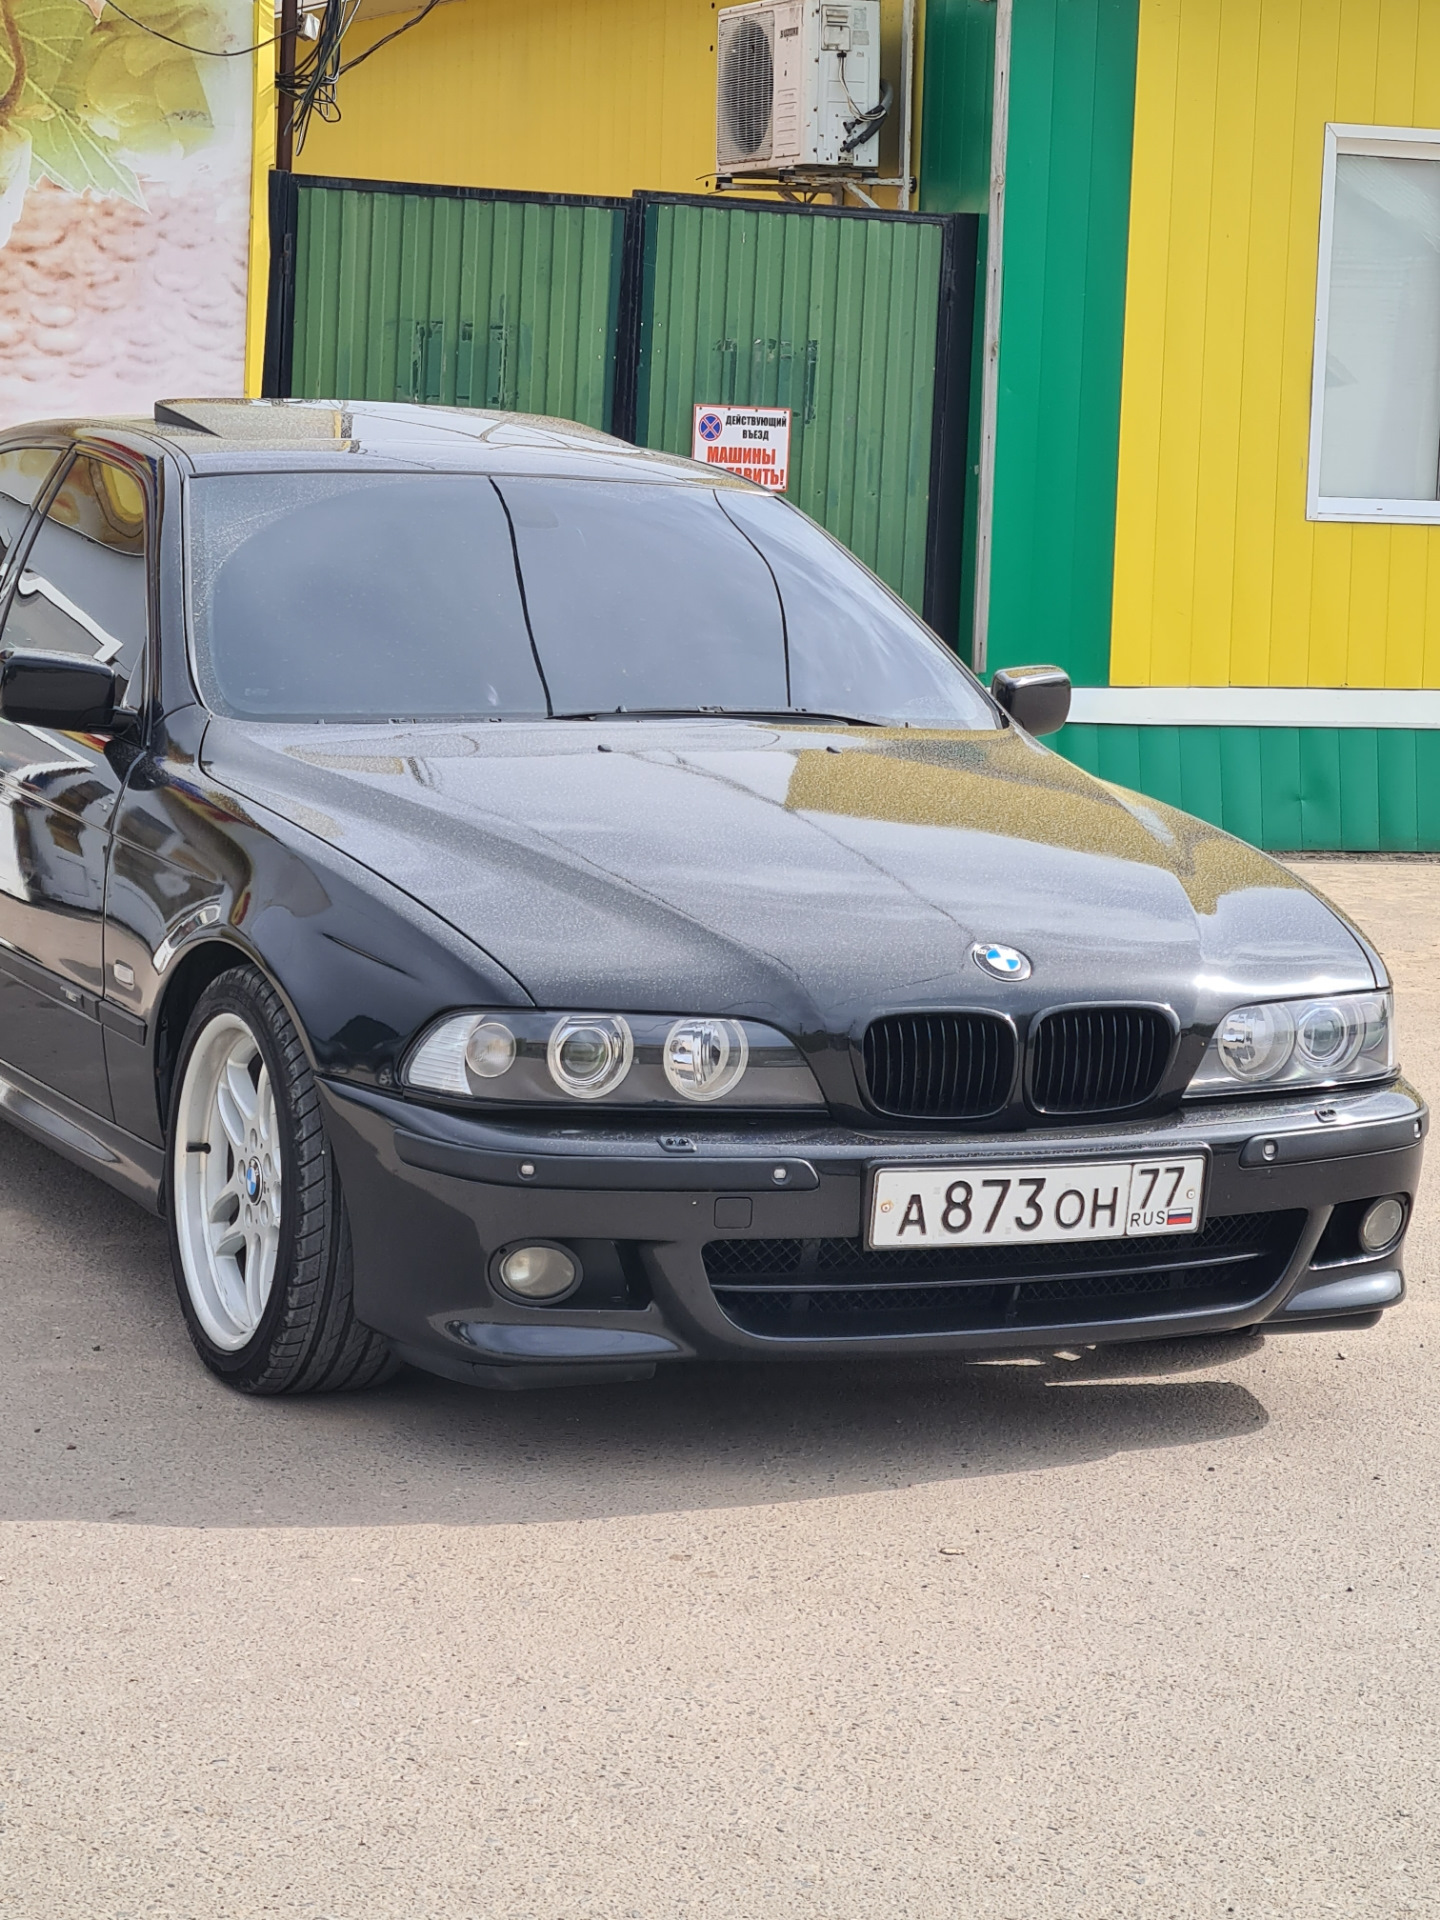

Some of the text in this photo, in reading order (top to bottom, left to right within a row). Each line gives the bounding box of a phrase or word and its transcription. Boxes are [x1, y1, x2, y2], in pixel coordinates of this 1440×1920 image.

[725, 414, 787, 428] ДЕЙСТВУЮЩИЙ
[742, 429, 769, 441] ВЪЕЗД
[707, 446, 776, 465] МАШИНЫ
[1139, 1166, 1186, 1209] 77
[1130, 1210, 1166, 1228] RUS
